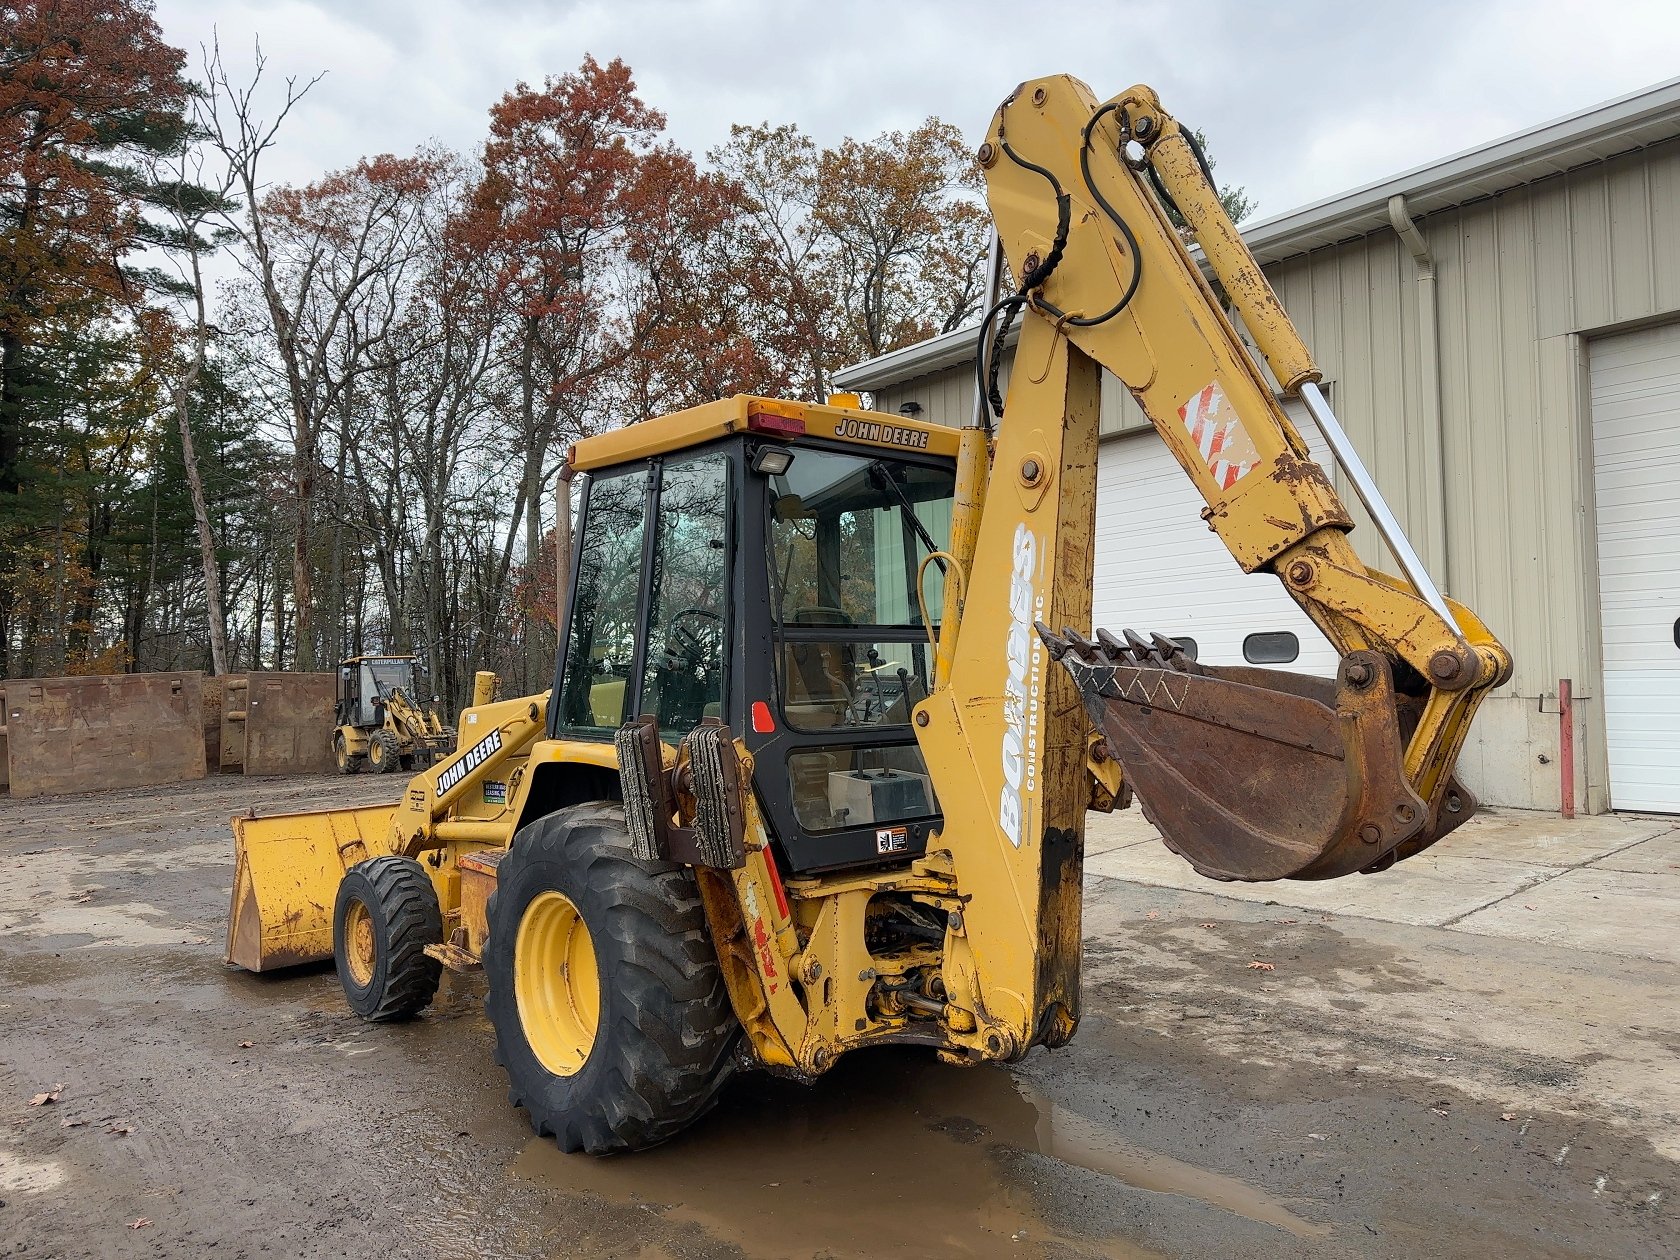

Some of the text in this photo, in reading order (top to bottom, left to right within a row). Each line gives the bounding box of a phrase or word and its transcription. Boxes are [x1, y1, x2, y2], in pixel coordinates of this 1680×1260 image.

[835, 418, 929, 448] JOHN DEERE
[1027, 587, 1045, 792] CONSTRUCTION NC.
[437, 730, 501, 796] JOHN DEERE
